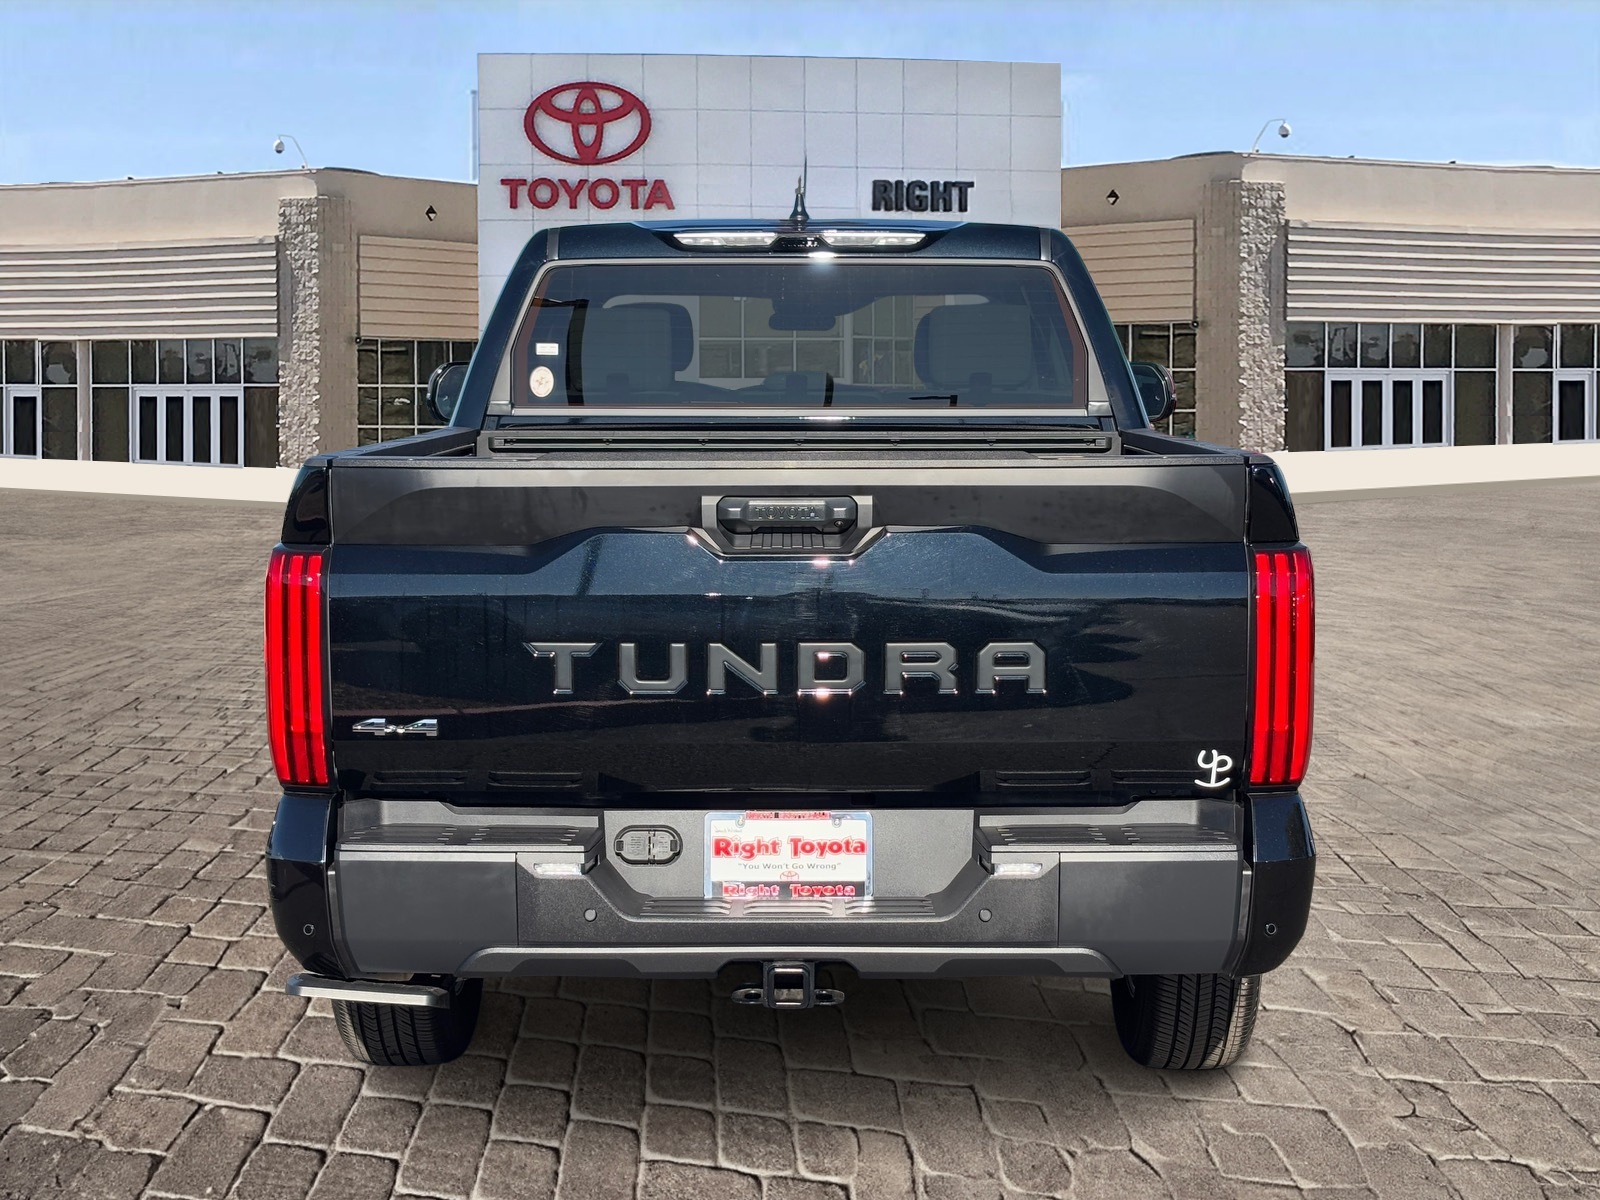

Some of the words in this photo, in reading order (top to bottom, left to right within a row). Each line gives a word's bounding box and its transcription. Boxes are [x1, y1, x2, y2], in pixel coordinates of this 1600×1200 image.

[501, 178, 675, 211] TOYOTA
[872, 179, 975, 213] RIGHT
[755, 506, 820, 520] TOYOTA
[523, 641, 1049, 695] TUNDRA
[713, 836, 781, 860] Right
[789, 836, 867, 858] Toyota
[793, 862, 804, 870] Go
[722, 883, 780, 897] Right
[790, 883, 856, 898] Toyota
